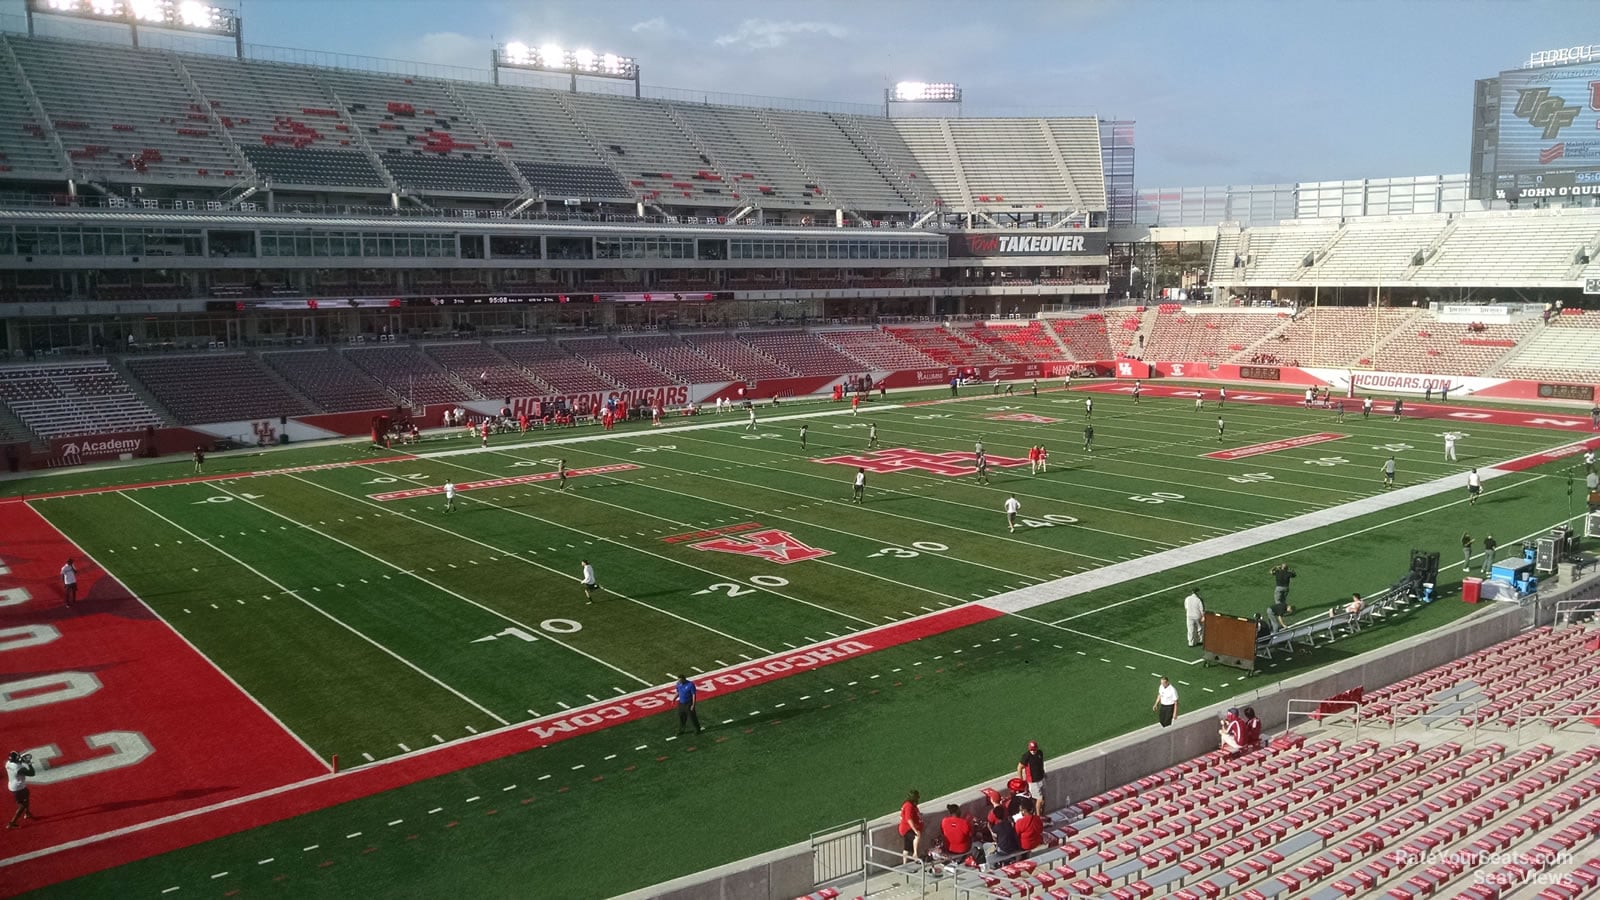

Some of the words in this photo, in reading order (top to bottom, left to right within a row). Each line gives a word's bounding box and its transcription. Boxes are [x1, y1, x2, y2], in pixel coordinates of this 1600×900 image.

[1513, 87, 1582, 139] UCF
[1519, 188, 1556, 197] JOHN
[82, 439, 142, 452] Academy
[1127, 491, 1186, 504] 50
[1021, 514, 1078, 528] 40
[880, 541, 949, 558] 30
[708, 575, 790, 598] 20
[496, 618, 583, 642] 10
